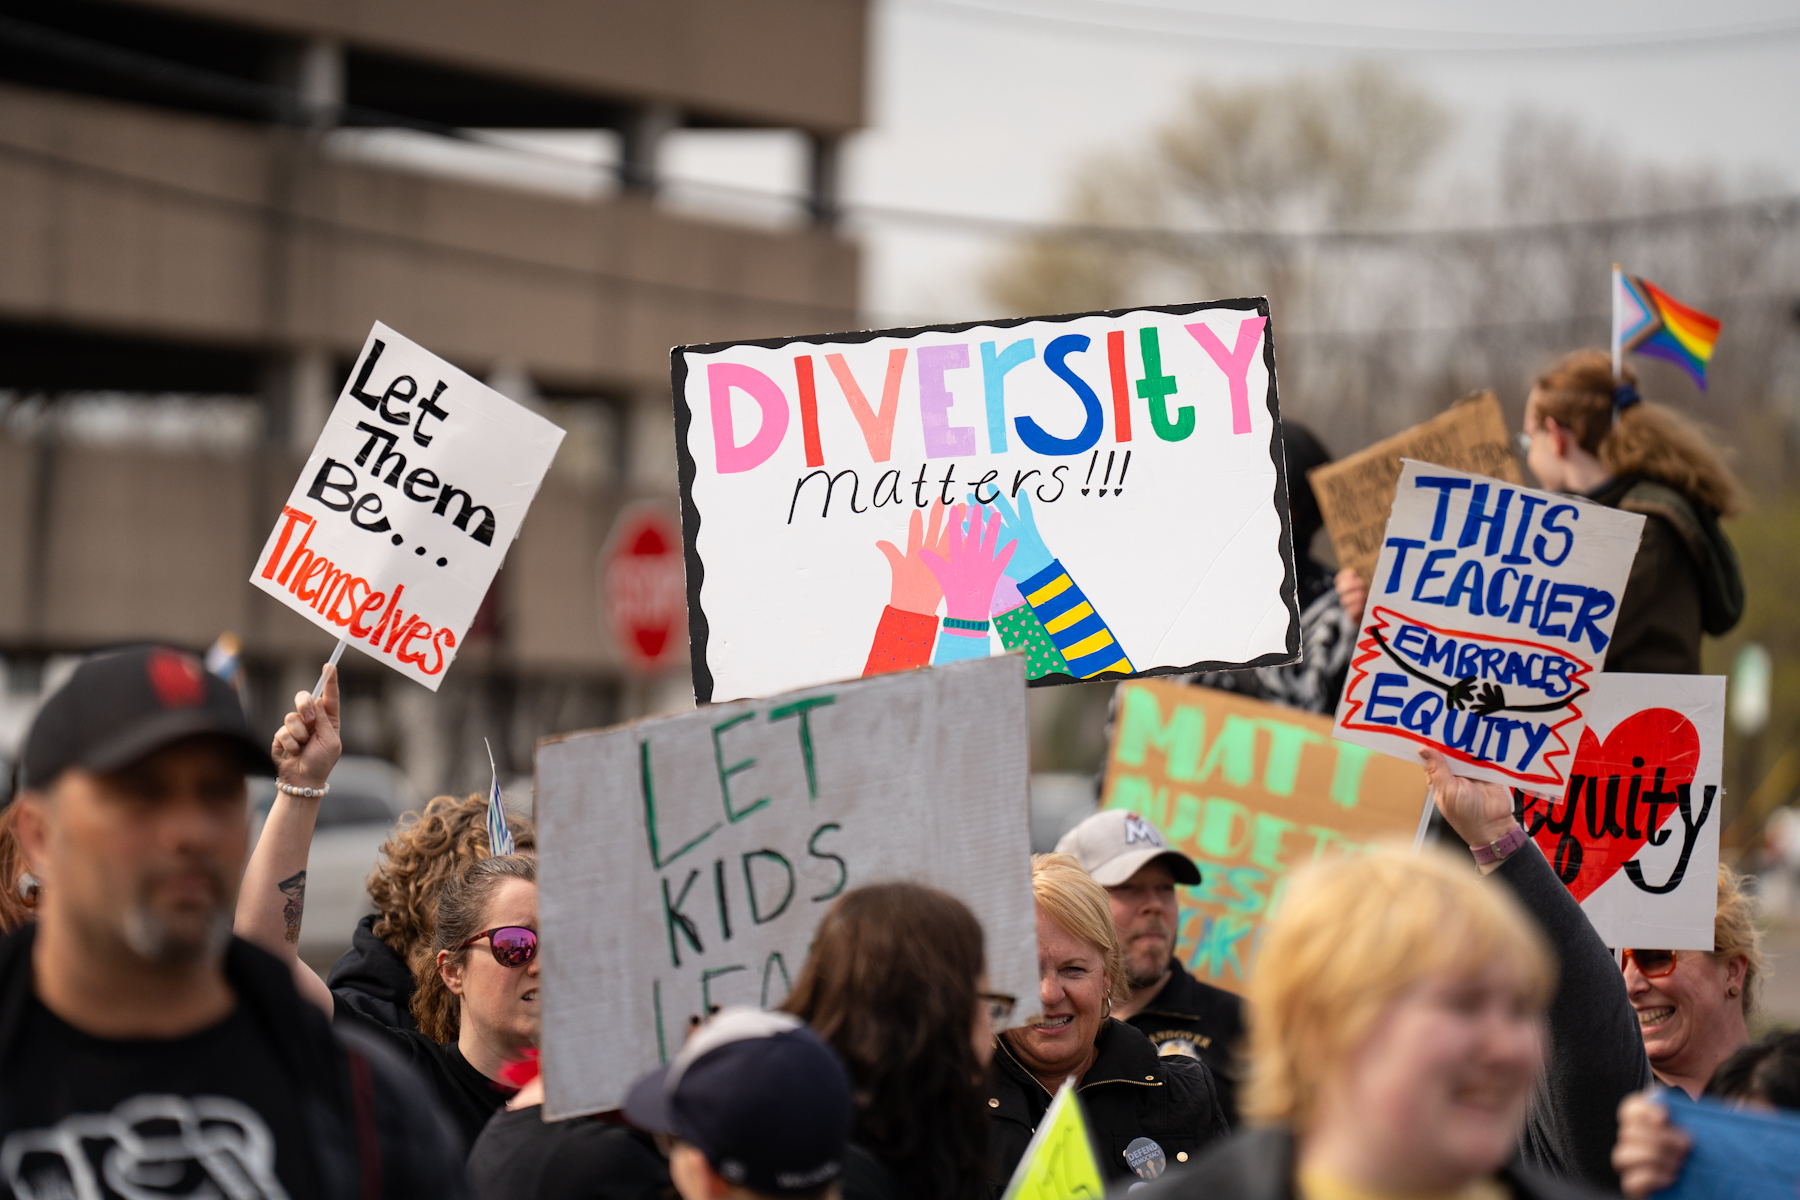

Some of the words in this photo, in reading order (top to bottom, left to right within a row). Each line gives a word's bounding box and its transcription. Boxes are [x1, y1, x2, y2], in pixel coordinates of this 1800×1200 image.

[349, 338, 449, 448] Let
[306, 457, 449, 567] Be...
[355, 421, 496, 547] Them
[787, 450, 1132, 525] matters!!!
[1415, 476, 1579, 567] THIS
[261, 505, 456, 675] Themselves
[1384, 537, 1616, 653] TEACHER
[1393, 624, 1577, 697] EMBRACES
[1116, 686, 1383, 809] MATT
[1364, 672, 1551, 772] EQUITY
[640, 694, 836, 870] LET
[661, 823, 847, 968] KIDS
[1127, 1142, 1158, 1161] DEFEND
[1131, 1150, 1161, 1167] DEMOCRACY
